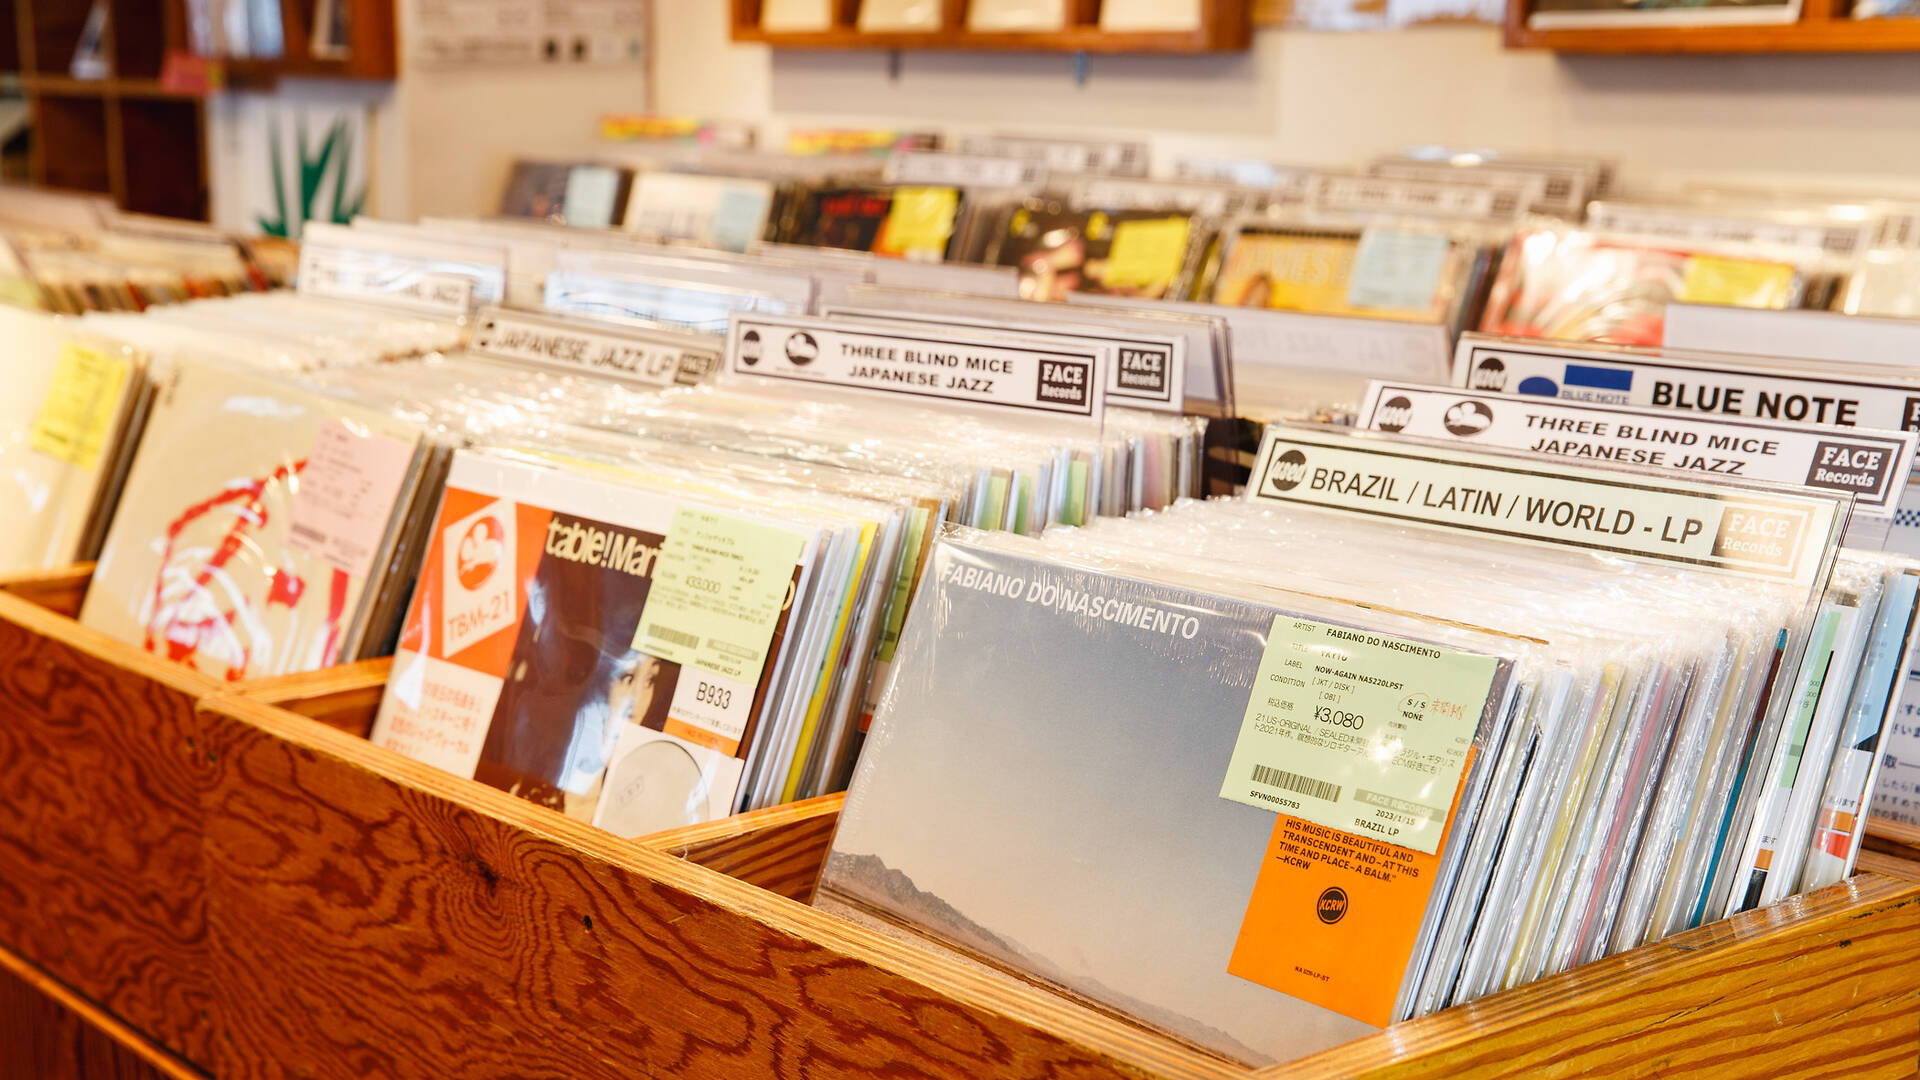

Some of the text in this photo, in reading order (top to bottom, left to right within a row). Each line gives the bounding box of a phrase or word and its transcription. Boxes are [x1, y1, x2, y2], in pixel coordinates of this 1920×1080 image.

[592, 350, 644, 373] JAZZ
[840, 344, 1013, 375] THREE BLIND MICE
[1122, 351, 1162, 372] FACE
[848, 366, 994, 394] JAPANESE JAZZ
[1042, 363, 1084, 384] FACE
[1120, 371, 1161, 388] Records
[1041, 383, 1083, 401] Records
[1561, 390, 1630, 406] BLUE NOTE
[1652, 381, 1860, 427] BLUE NOTE
[1525, 413, 1781, 457] THREE BLIND MICE
[1531, 438, 1747, 476] JAPANESE JAZZ
[1819, 446, 1883, 471] FACE
[1814, 467, 1876, 488] Records
[1310, 467, 1400, 502] BRAZIL
[1406, 480, 1420, 504] /
[1423, 483, 1502, 517] LATIN
[1506, 495, 1520, 519] /
[1525, 496, 1636, 537] WORLD
[1661, 516, 1704, 546] LP
[1727, 513, 1791, 539] FACE
[1721, 535, 1784, 557] Records
[941, 562, 1200, 640] FABIANO DO NASCIMENTO
[447, 591, 510, 641] TBM-21
[1293, 622, 1441, 659] ARTIST FABIANO DO NASCIMENTO
[1270, 673, 1306, 688] CONDITION
[1284, 659, 1303, 669] LABEL
[1314, 665, 1358, 681] NOW-AGAIN
[696, 682, 731, 710] B933
[1314, 705, 1364, 730] ¥3,080
[1402, 711, 1423, 721] NONE
[1250, 790, 1301, 810] SFVN00055783
[1354, 818, 1400, 836] BRAZIL LP
[1375, 809, 1416, 826] 2023/1/15
[1279, 841, 1301, 856] TIME
[1300, 847, 1320, 860] AND
[1285, 819, 1414, 863] HIS MUSIC IS BEAUTIFUL AND
[1282, 830, 1354, 858] TRANSCENDENT
[1397, 864, 1420, 877] THIS
[1319, 899, 1346, 911] KCRW
